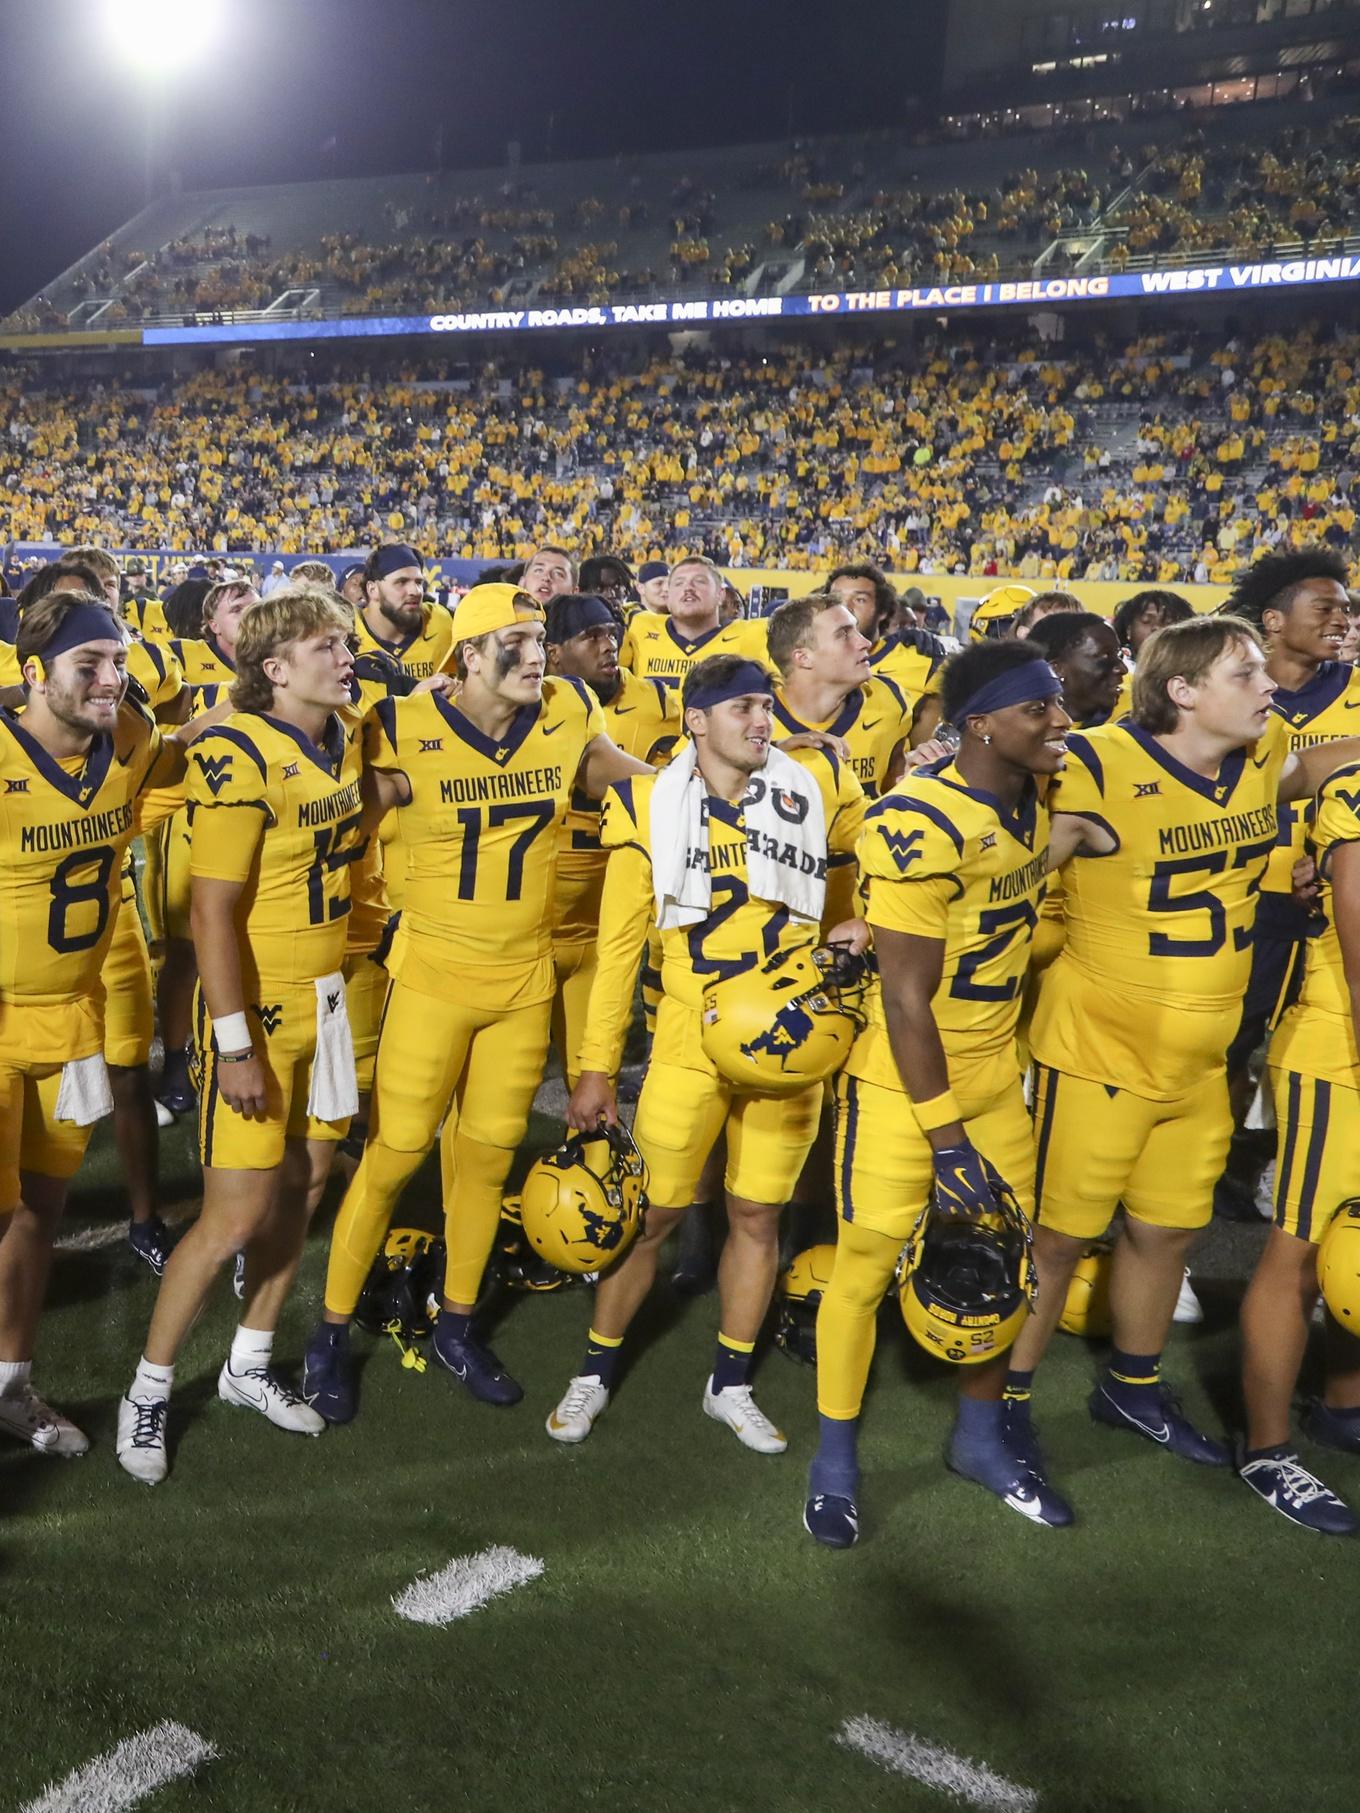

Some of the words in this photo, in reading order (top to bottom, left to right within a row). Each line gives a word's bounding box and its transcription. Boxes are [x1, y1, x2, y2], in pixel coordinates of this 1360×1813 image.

[808, 294, 840, 313] TO
[845, 290, 891, 310] THE
[897, 285, 977, 307] PLACE
[983, 284, 993, 301] I
[999, 277, 1110, 301] BELONG
[1141, 267, 1223, 293] WEST
[430, 311, 525, 331] COUNTRY
[528, 308, 607, 328] ROADS,
[612, 303, 667, 323] TAKE
[672, 301, 708, 321] ME
[713, 297, 782, 317] HOME
[440, 766, 562, 804] MOUNTAINEERS
[456, 797, 556, 902] 17
[1158, 803, 1278, 855] MOUNTAINEERS
[48, 845, 116, 954] 8
[949, 882, 1047, 1003] 2
